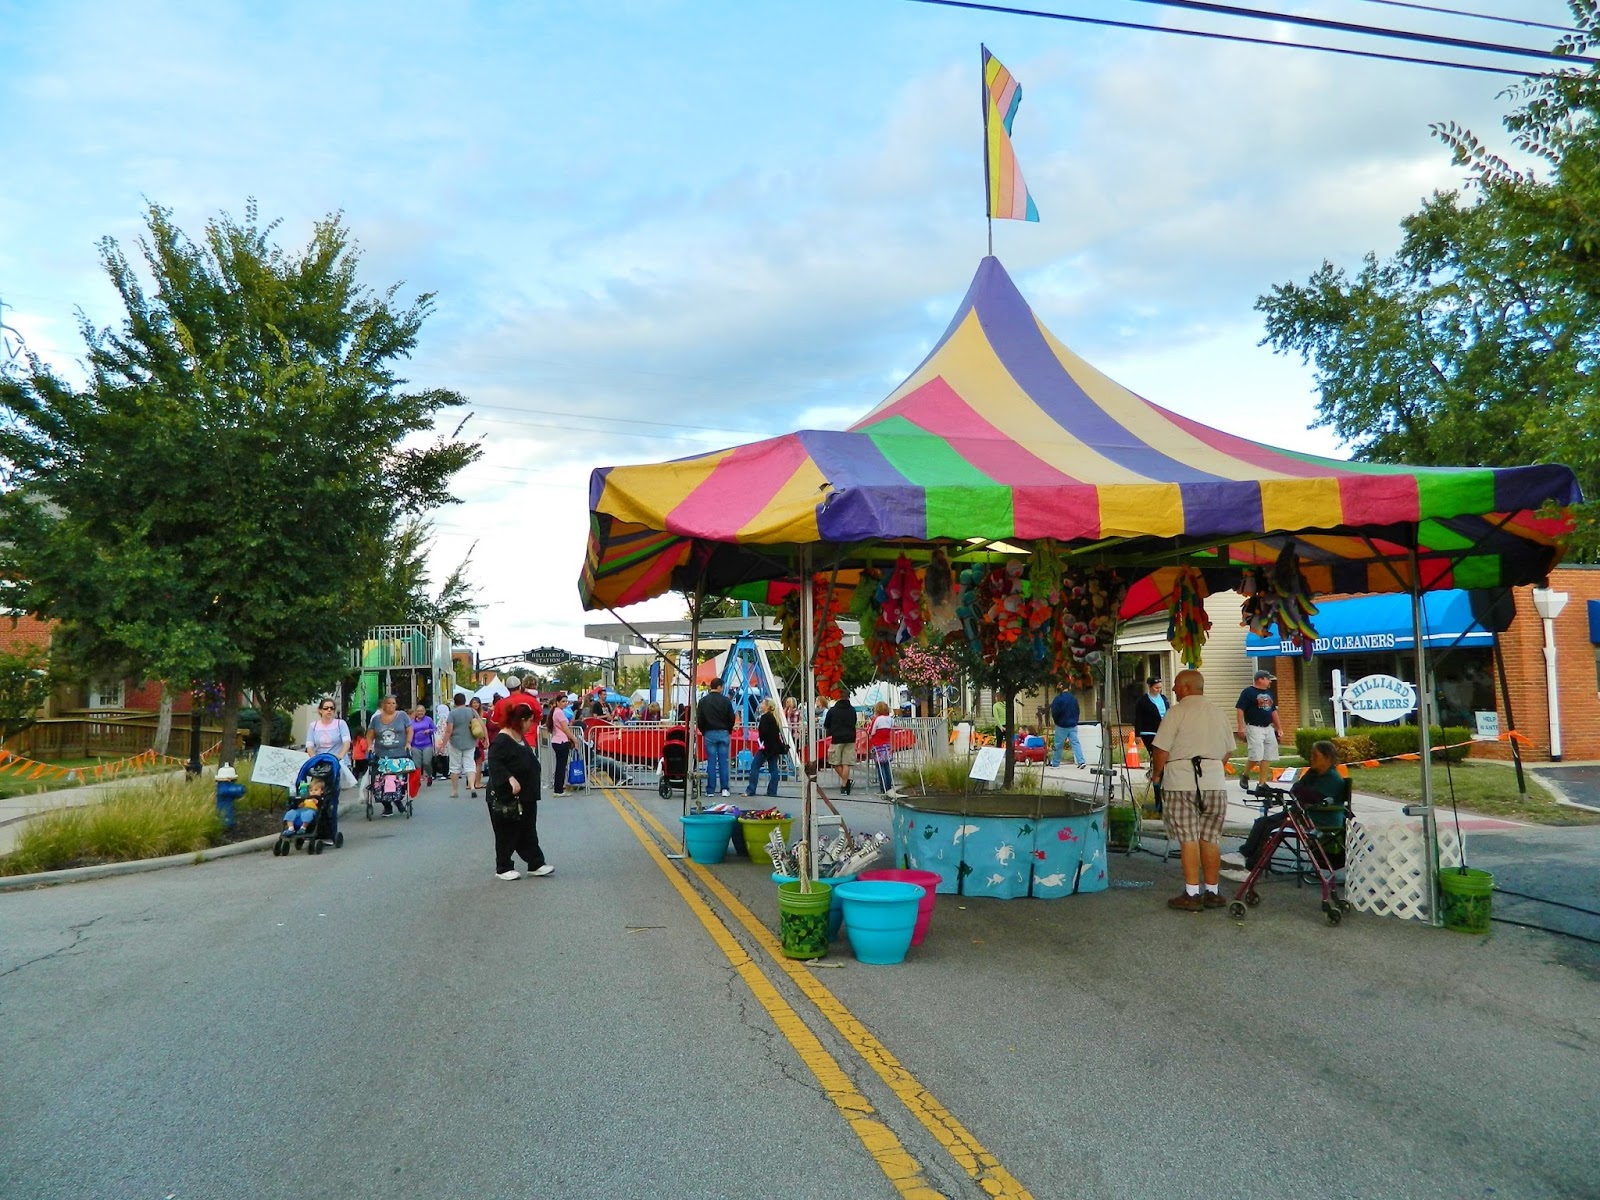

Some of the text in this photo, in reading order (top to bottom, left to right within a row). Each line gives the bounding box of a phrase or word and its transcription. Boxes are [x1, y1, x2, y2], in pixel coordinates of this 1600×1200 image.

[1280, 633, 1395, 653] HILRD CLEANERS
[1351, 677, 1410, 698] HILLIARD
[1352, 698, 1410, 710] CLEANERS
